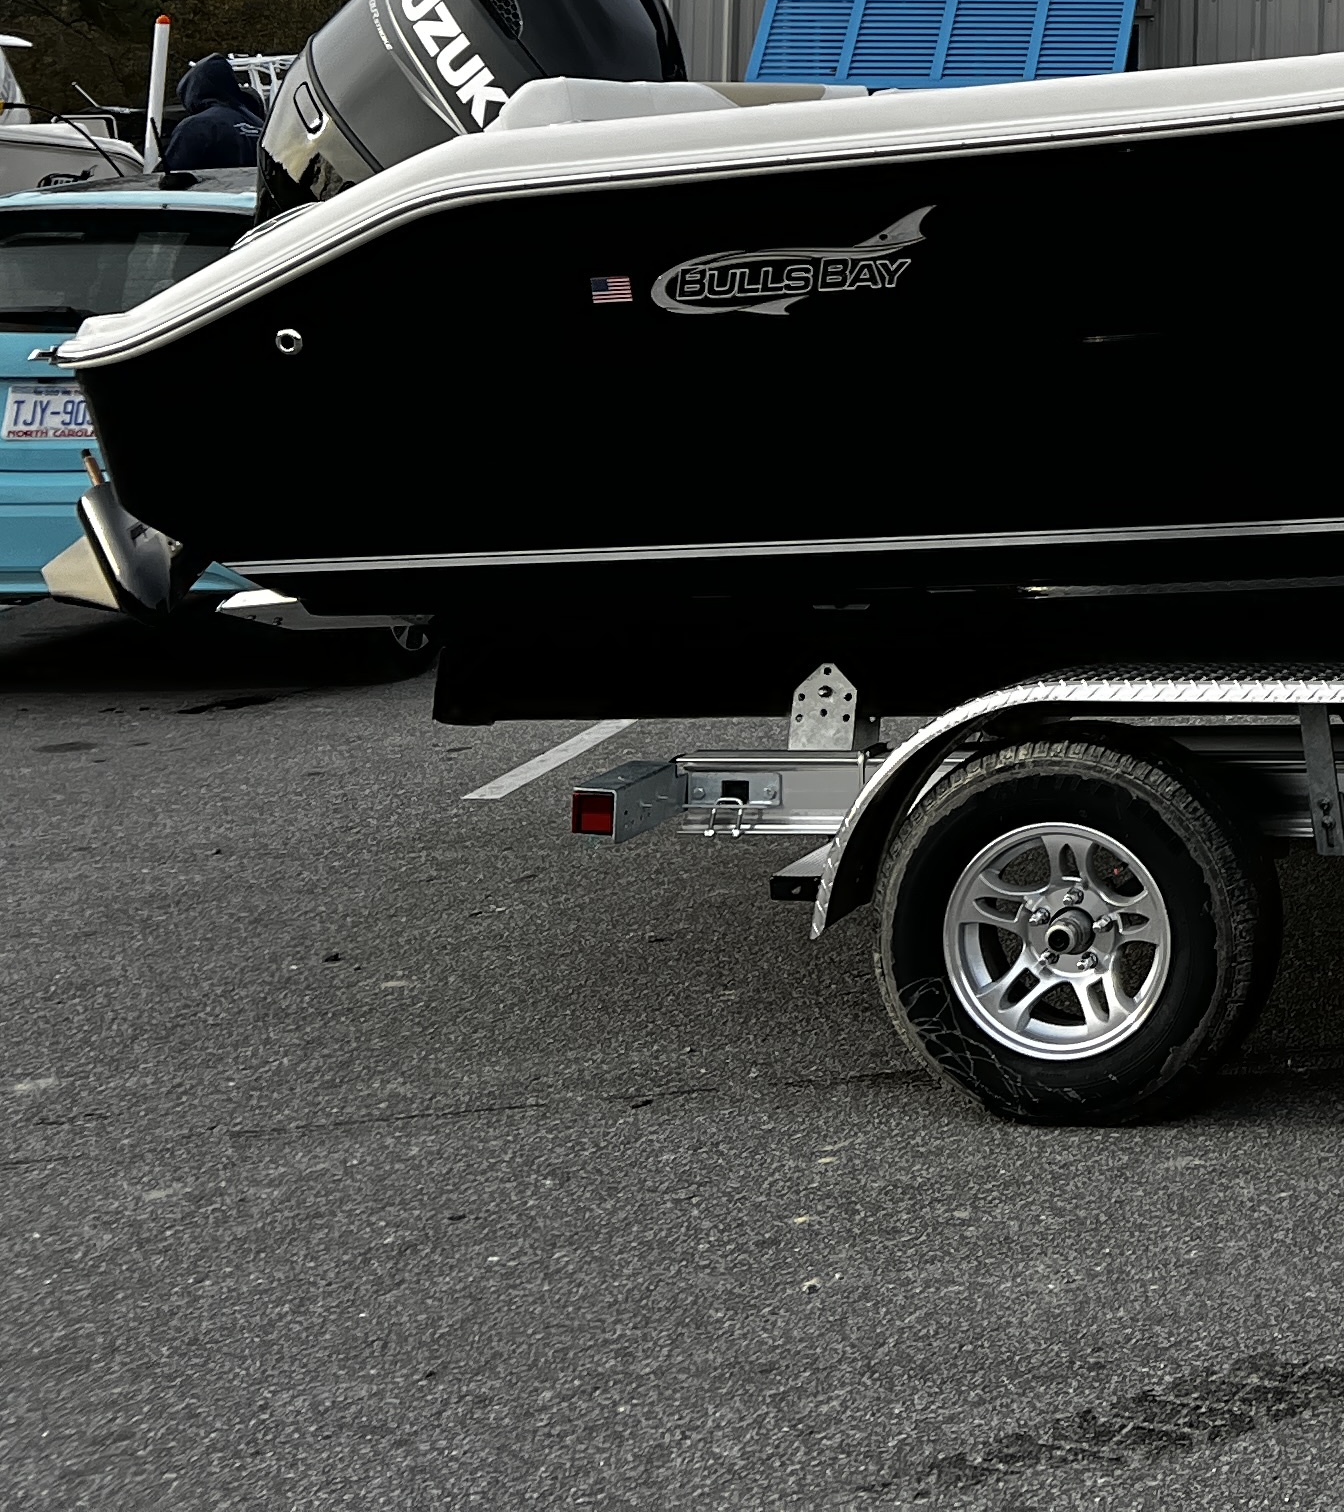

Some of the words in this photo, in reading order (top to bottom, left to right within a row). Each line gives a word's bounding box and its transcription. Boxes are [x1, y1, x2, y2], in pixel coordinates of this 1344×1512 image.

[676, 264, 813, 301] BULLS
[818, 257, 912, 291] BAY
[13, 399, 93, 426] TJY-90
[7, 429, 48, 438] NORTH
